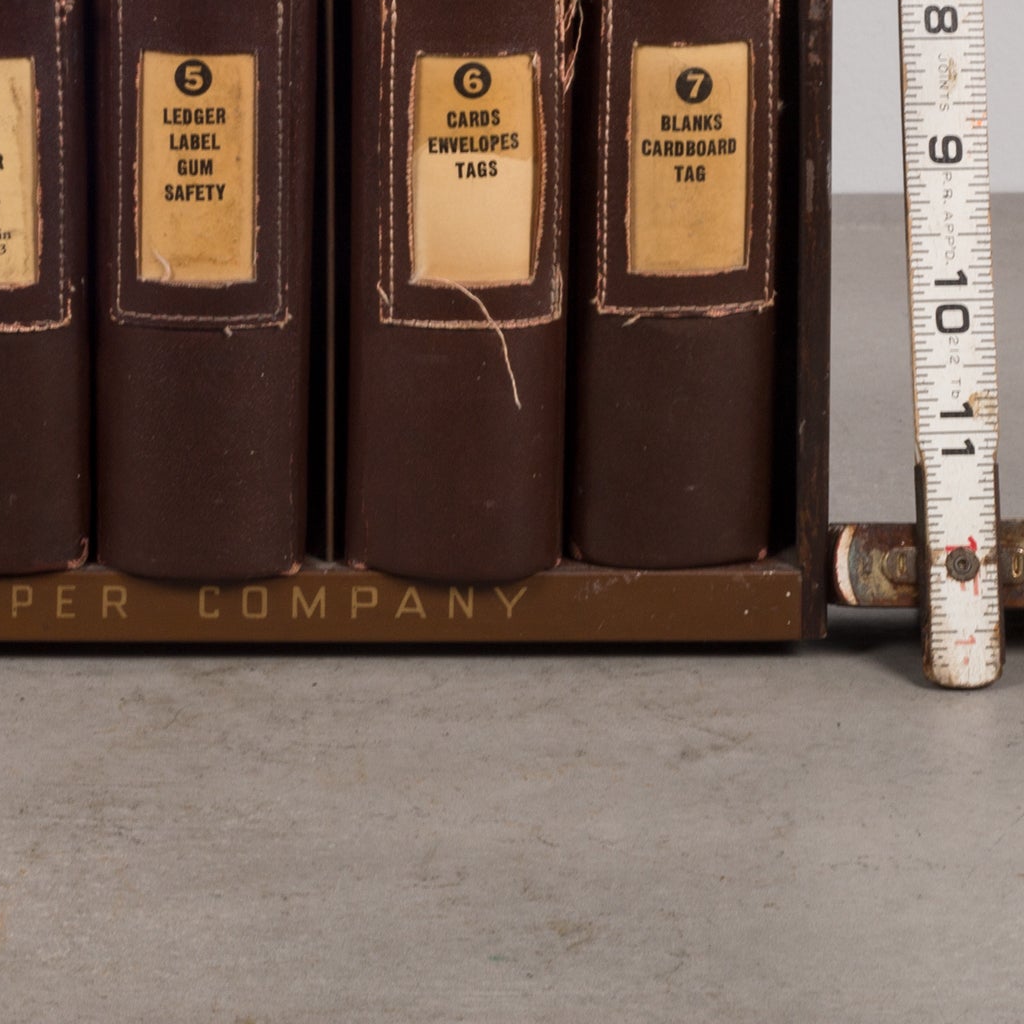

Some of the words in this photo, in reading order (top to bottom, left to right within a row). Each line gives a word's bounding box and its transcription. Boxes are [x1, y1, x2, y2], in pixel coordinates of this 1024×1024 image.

[923, 5, 959, 35] 8
[937, 52, 951, 112] JOINTS
[163, 107, 226, 126] LEDGER
[446, 108, 501, 129] CARDS
[660, 113, 723, 132] BLANKS
[169, 133, 221, 151] LABEL
[427, 132, 519, 154] ENVELOPES
[641, 138, 737, 157] CARDBOARD
[928, 135, 963, 164] 9
[177, 158, 213, 177] GUM
[455, 160, 498, 179] TAGS
[674, 164, 706, 183] TAG
[164, 183, 226, 202] SAFETY
[0, 243, 7, 255] 3
[197, 585, 528, 620] COMPANY
